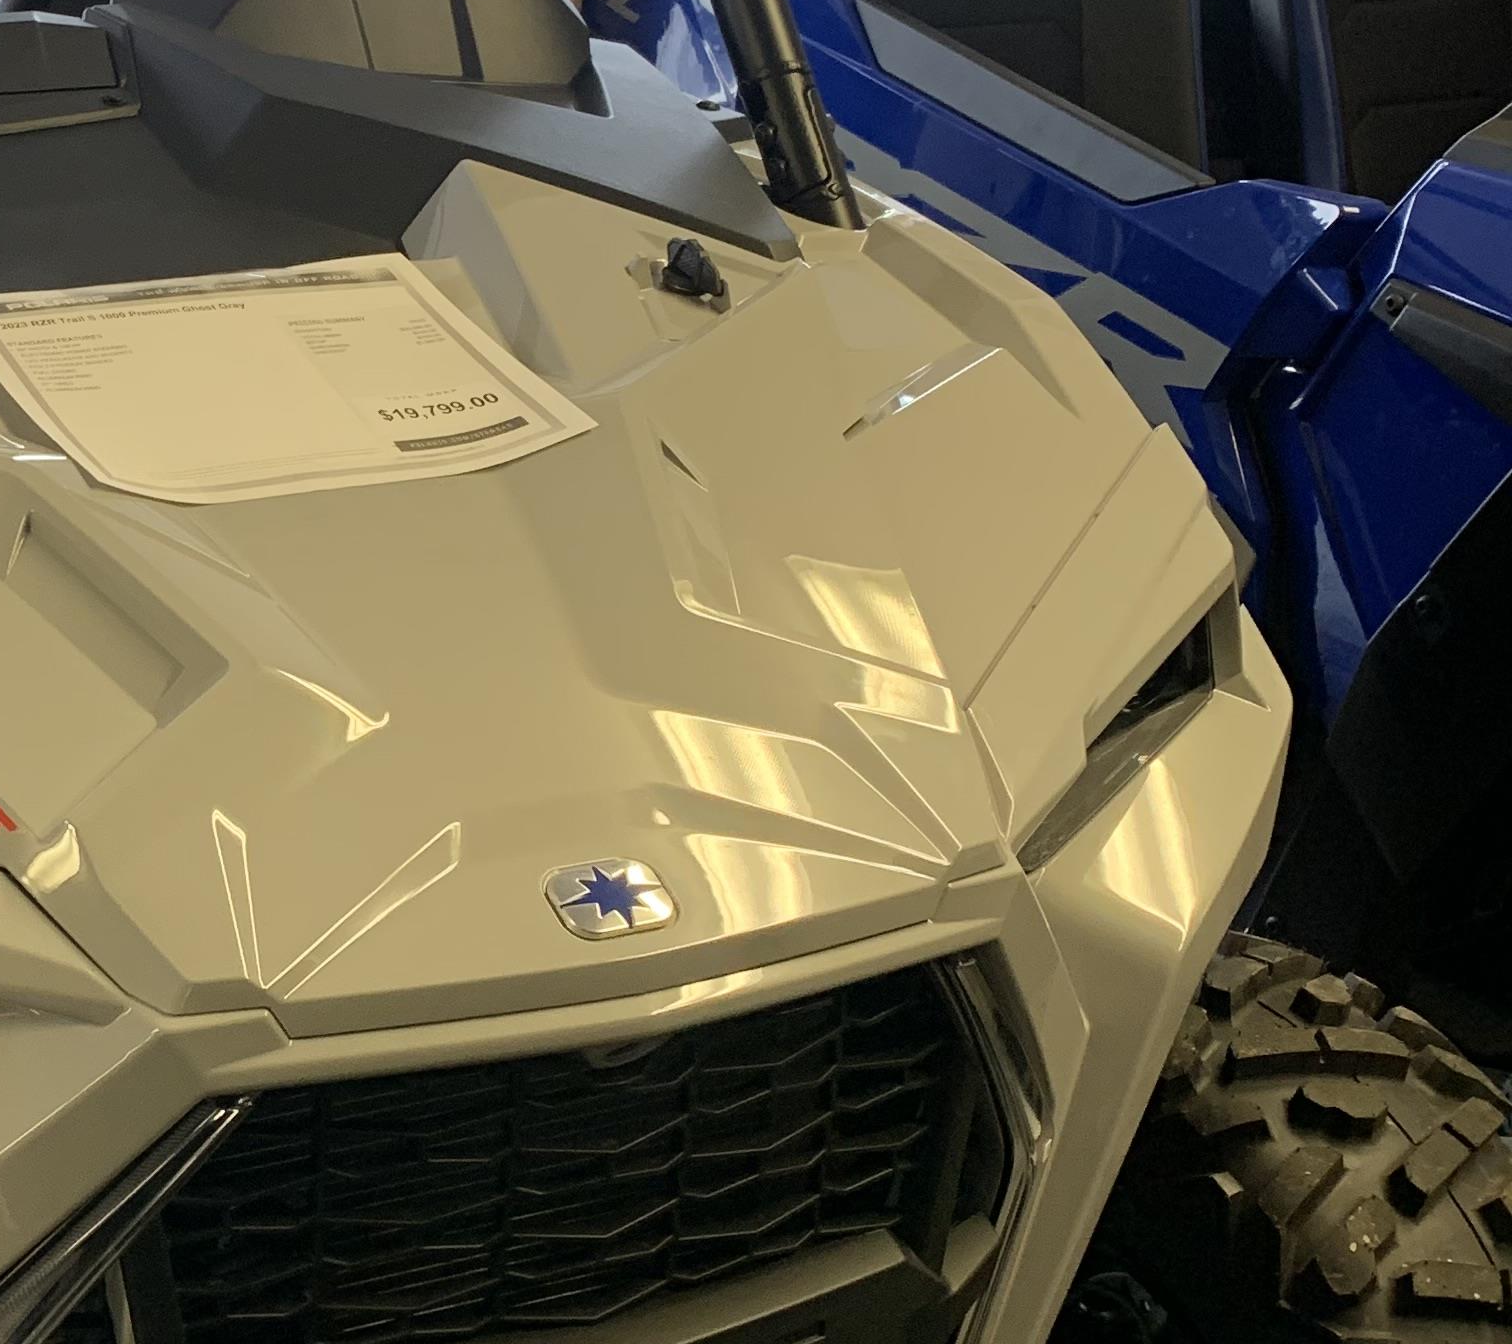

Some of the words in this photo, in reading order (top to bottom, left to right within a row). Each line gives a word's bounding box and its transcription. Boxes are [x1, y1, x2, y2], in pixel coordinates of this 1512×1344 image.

[0, 319, 30, 331] 2023
[31, 316, 58, 328] RZR
[59, 313, 86, 324] Trail
[128, 306, 181, 318] Premium
[181, 302, 216, 314] Ghost
[218, 301, 247, 313] Gray
[377, 391, 500, 423] $19,799.00
